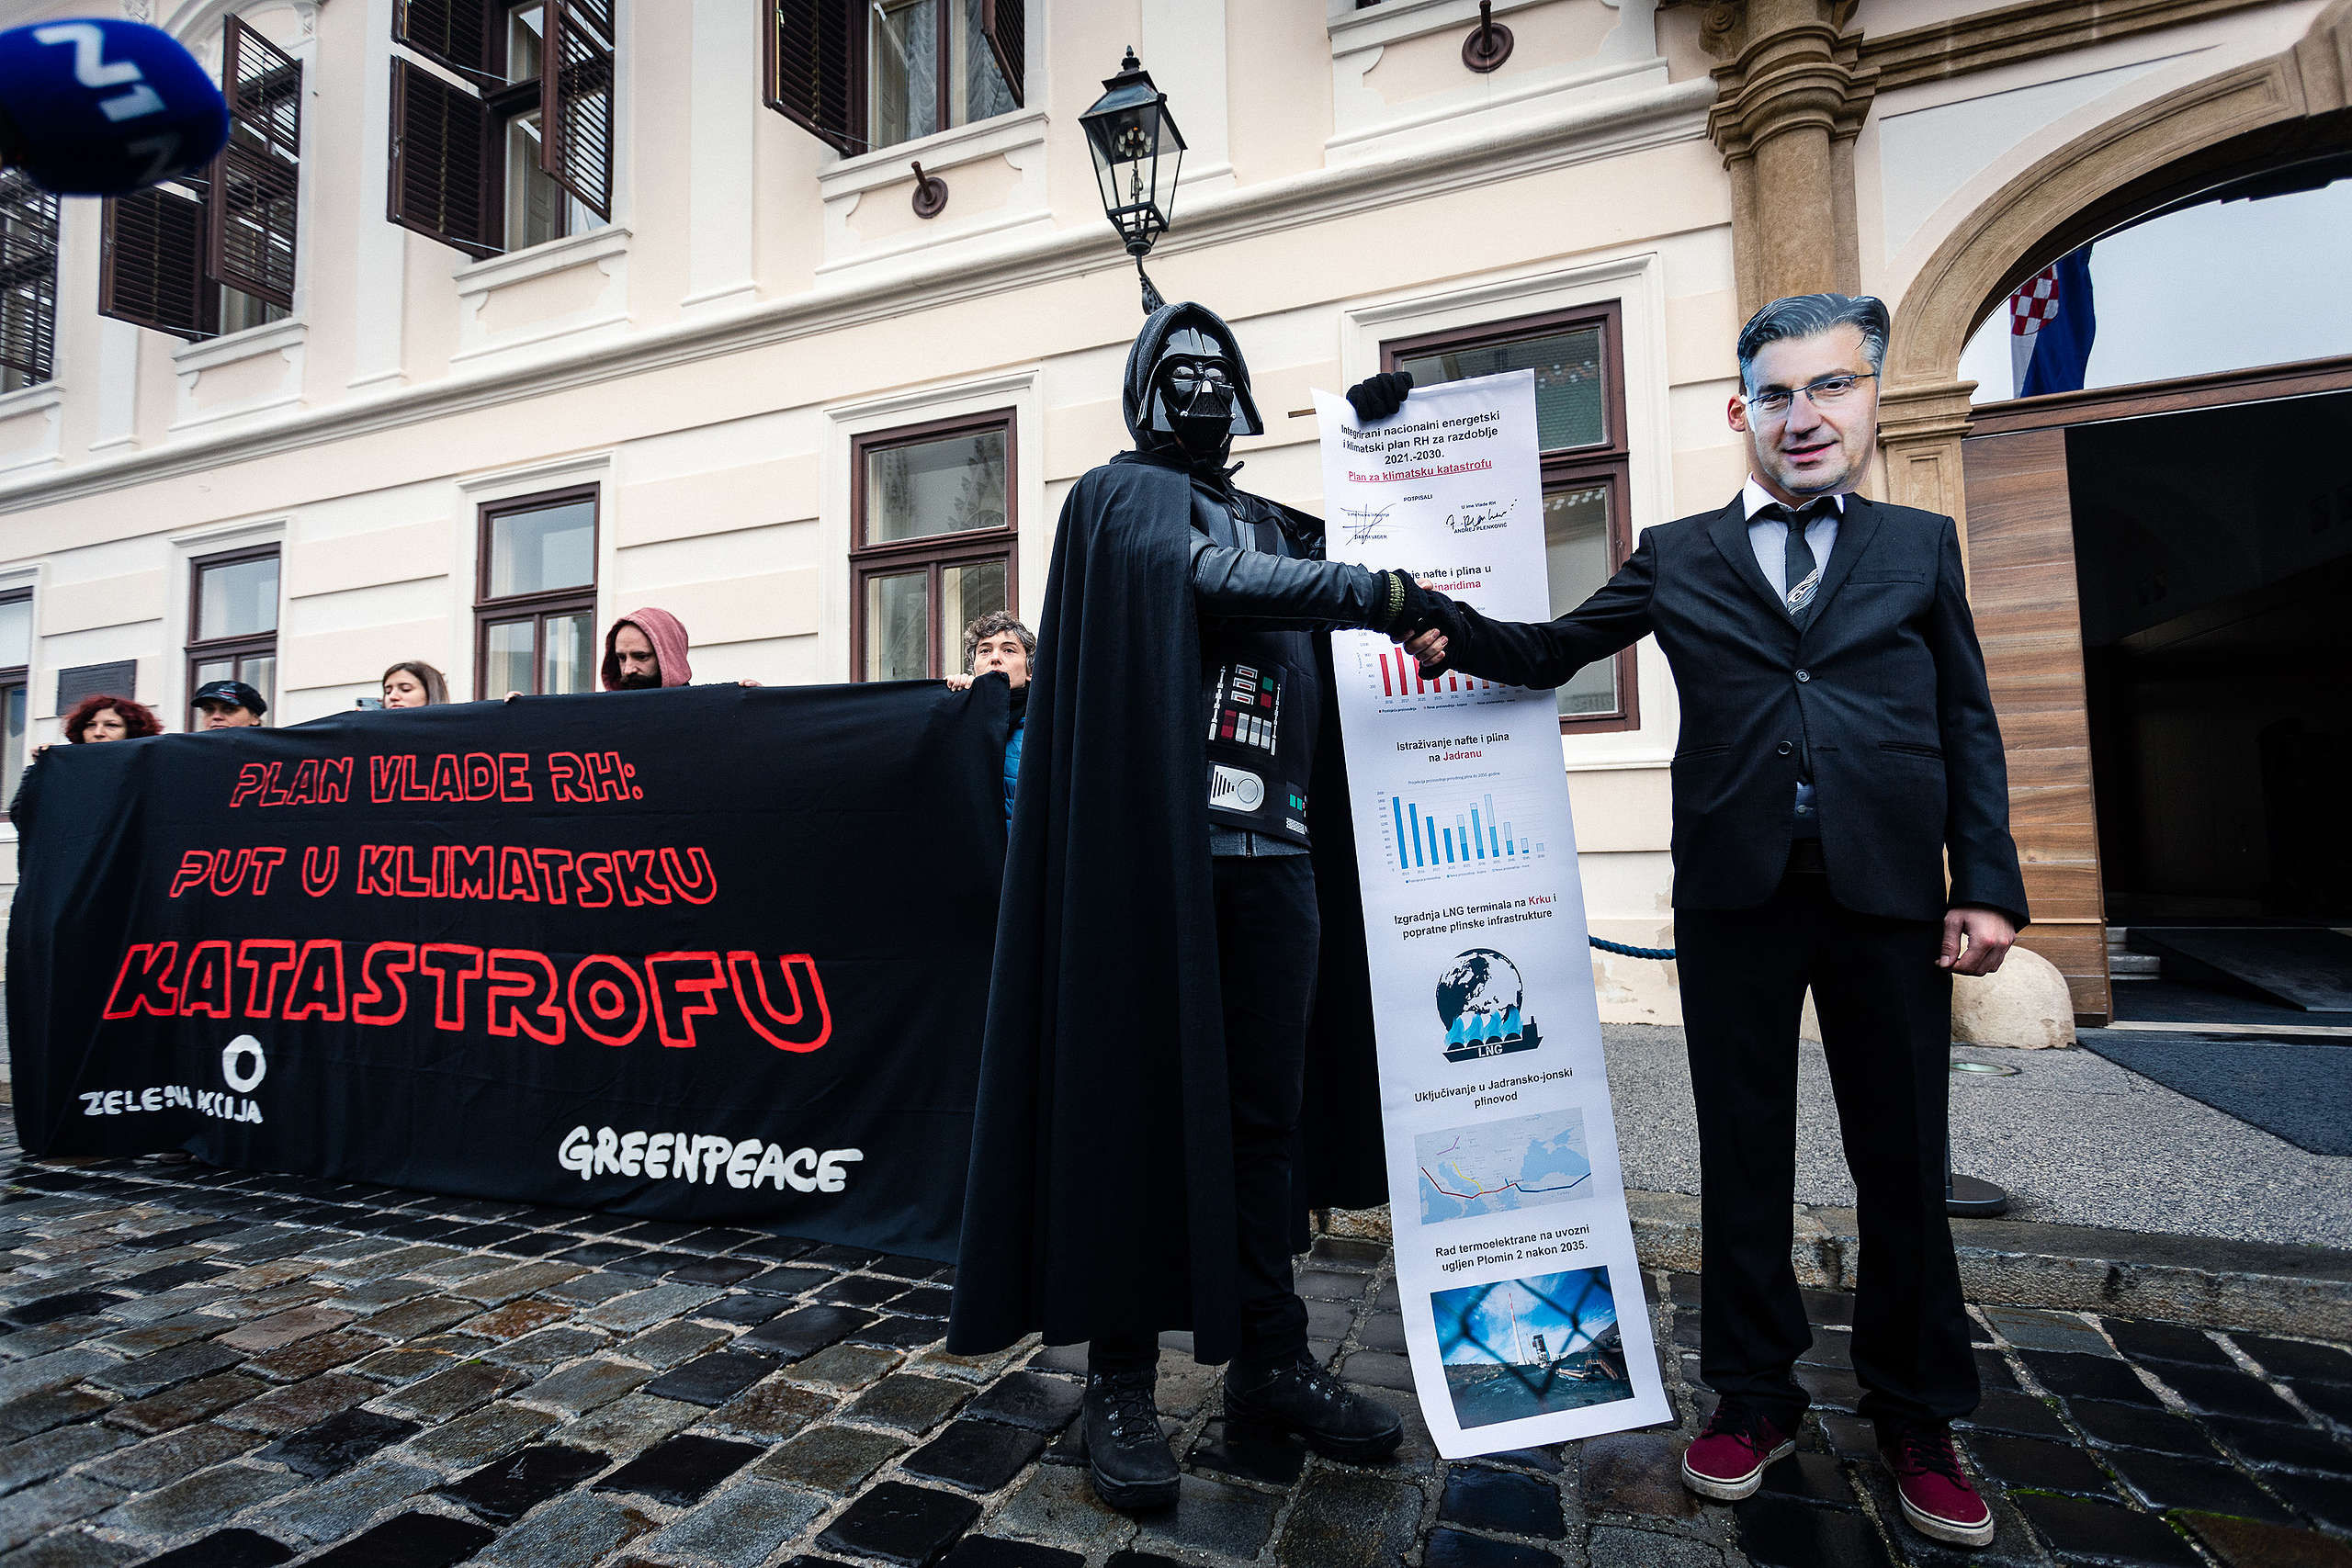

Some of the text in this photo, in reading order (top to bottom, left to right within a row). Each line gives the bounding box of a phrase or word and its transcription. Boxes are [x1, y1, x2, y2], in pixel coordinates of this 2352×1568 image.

[1341, 411, 1500, 439] Integrirani nacionalni energetski
[1347, 440, 1385, 454] klimatski
[1387, 439, 1410, 452] plan
[1414, 435, 1430, 446] RH
[1432, 434, 1445, 445] za
[1448, 426, 1498, 443] razdoblje
[1349, 458, 1493, 481] Plan za klimatsku katastrofu
[1385, 448, 1445, 465] 2021.-2030.
[1423, 570, 1448, 579] nafte
[1456, 567, 1482, 578] plina
[1434, 581, 1481, 592] inaridima
[1396, 738, 1452, 751] Istraživanje
[1454, 736, 1478, 746] nafte
[1487, 732, 1510, 744] plina
[1429, 750, 1482, 762] na Jadranu
[230, 750, 644, 808] PLAN VLADE RH:
[169, 845, 718, 908] PUT U KLIMATSKU
[1394, 909, 1441, 925] Izgradnja
[1442, 906, 1464, 918] LNG
[1466, 899, 1512, 914] terminala
[1514, 898, 1526, 908] na
[1528, 894, 1551, 906] Krku
[1402, 908, 1553, 940] popratne plinske infrastrukture
[104, 939, 834, 1054] KATASTROFU
[1477, 1044, 1503, 1057] LNG
[1415, 1067, 1573, 1102] Uključivanje u Jadransko-jonski
[1474, 1091, 1518, 1109] plinovod
[559, 1125, 864, 1192] GREENPEACE
[1435, 1224, 1589, 1258] Rad termoelektrane na uvozni
[1442, 1240, 1589, 1272] ugljen Plomin 2 nakon 2035.
